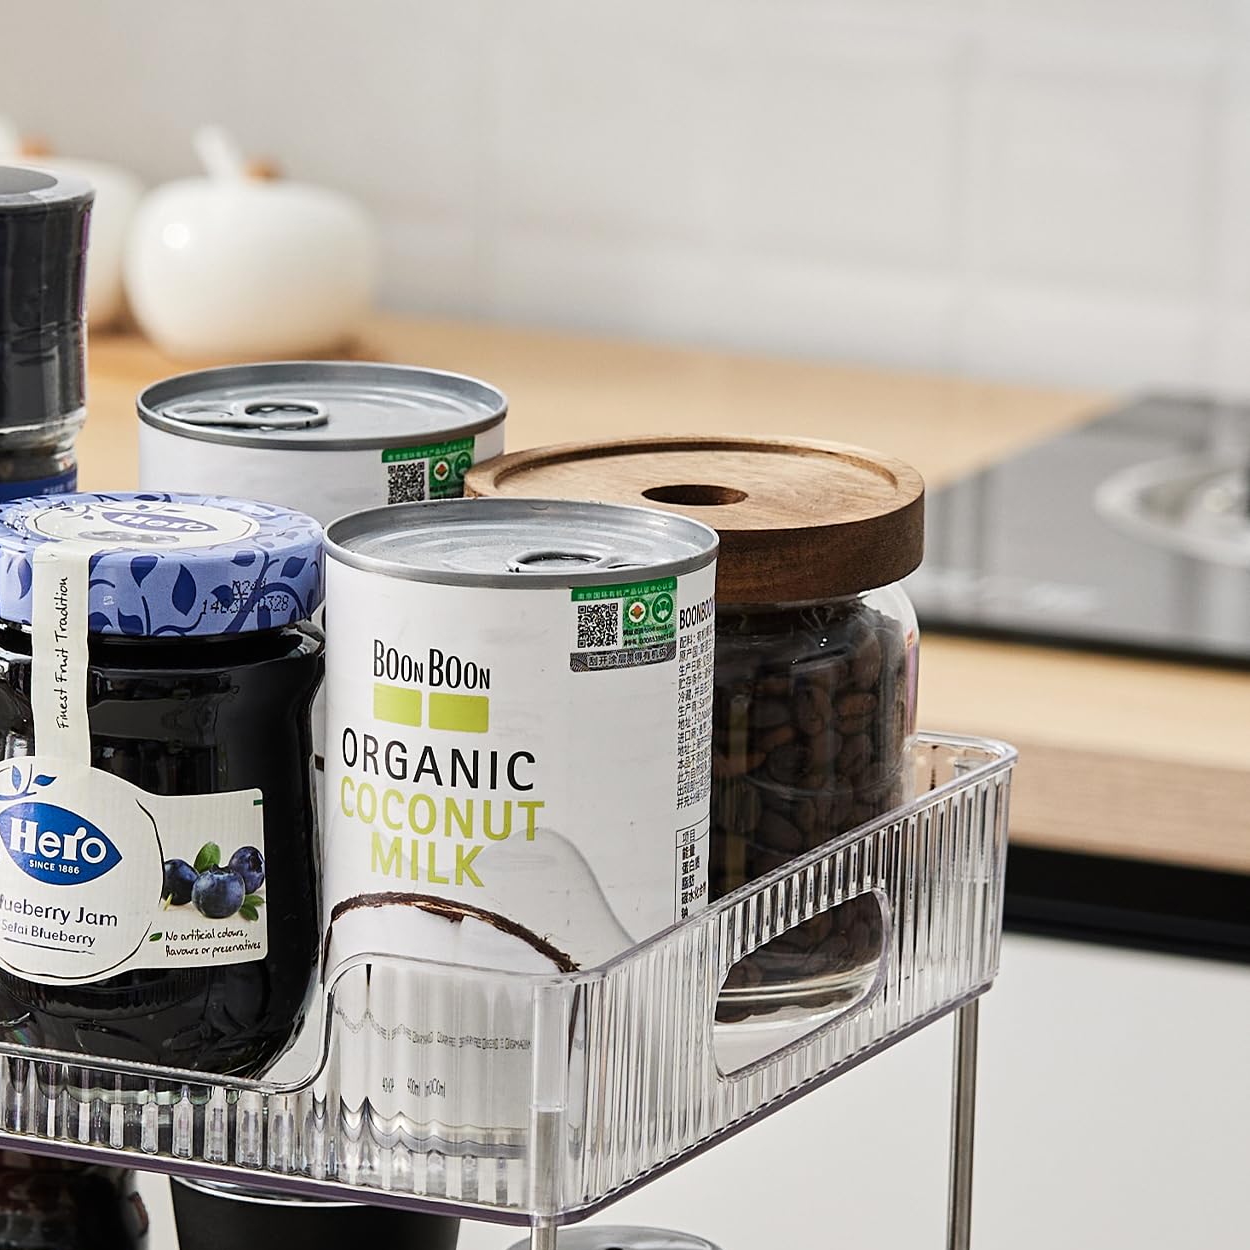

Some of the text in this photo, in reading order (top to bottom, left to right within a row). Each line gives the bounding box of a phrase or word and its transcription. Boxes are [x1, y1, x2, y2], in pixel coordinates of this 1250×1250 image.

[110, 512, 210, 532] Hero
[54, 576, 69, 729] Finest Fruit Tradition
[342, 727, 537, 792] ORGANIC
[340, 775, 546, 842] COCONUT
[9, 817, 107, 864] Hero
[29, 859, 80, 875] SINCE 1886
[370, 830, 485, 888] MILK
[75, 907, 118, 927] Jam
[31, 925, 96, 948] Blueberry
[165, 931, 179, 942] No
[181, 928, 215, 942] artificial
[202, 947, 210, 955] or
[212, 940, 261, 958] preservatives
